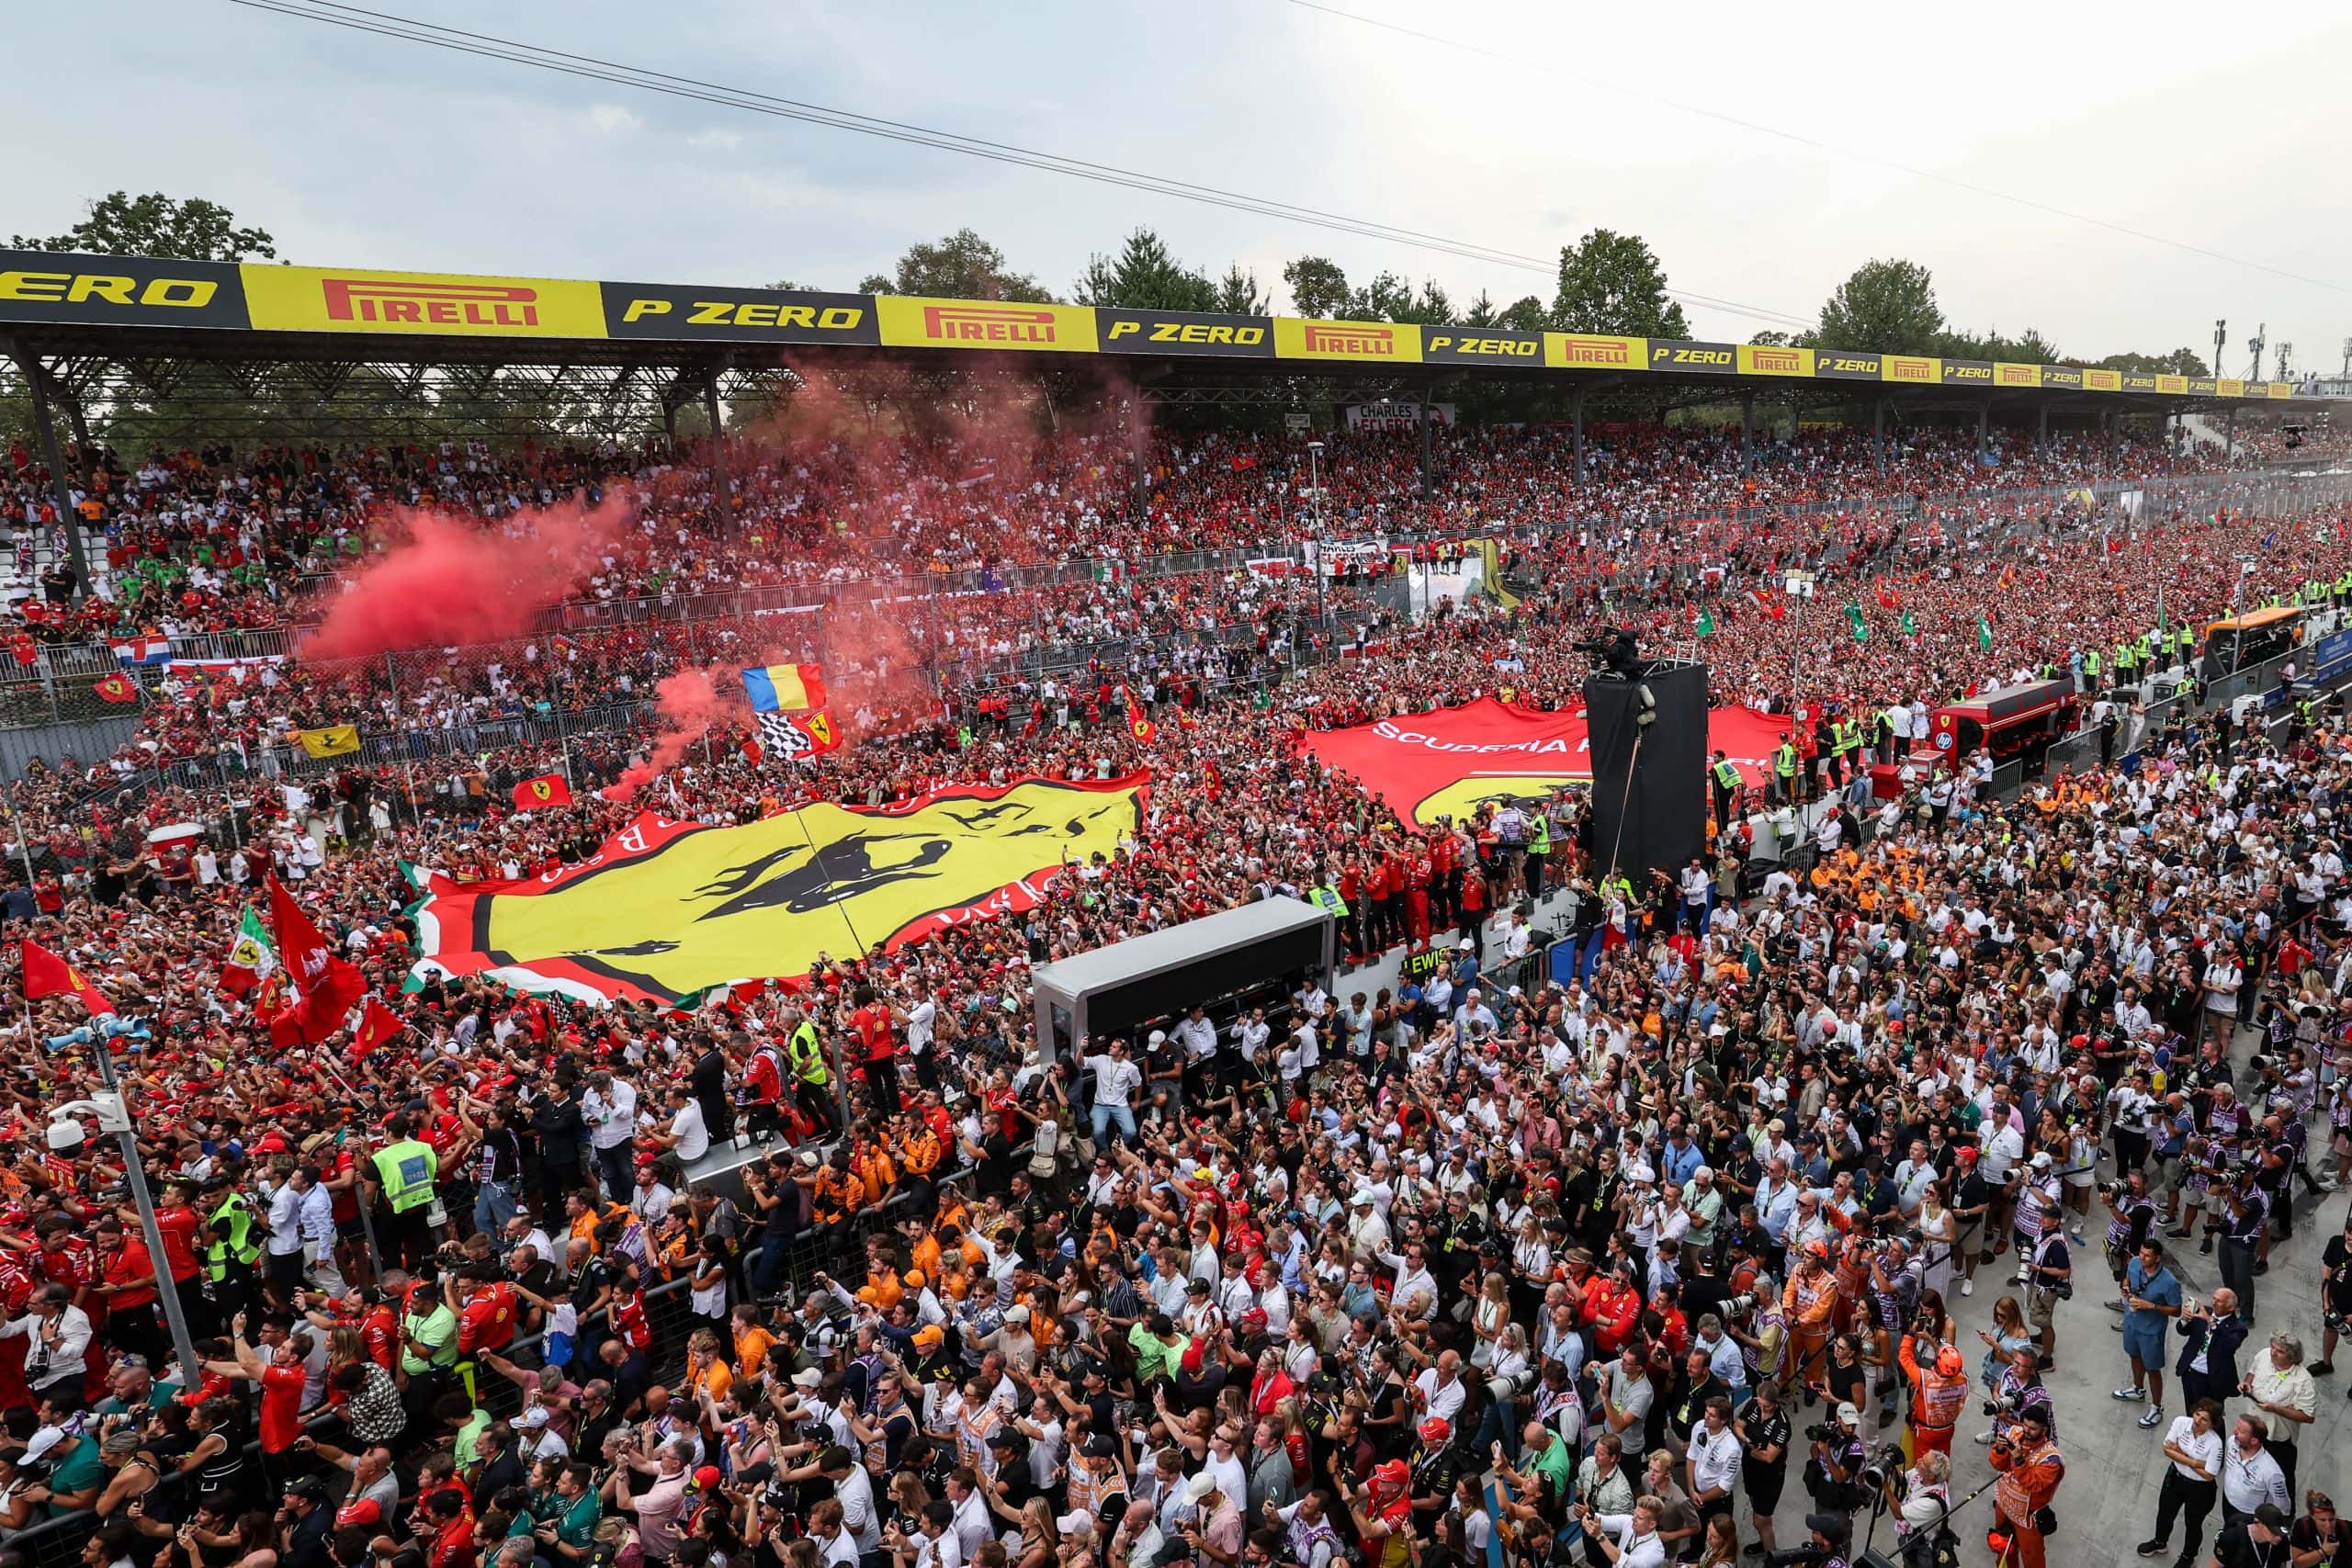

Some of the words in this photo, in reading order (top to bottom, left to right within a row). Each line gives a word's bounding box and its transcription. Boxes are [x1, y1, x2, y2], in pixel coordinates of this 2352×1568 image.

[322, 278, 538, 326] PIRELLI
[622, 299, 673, 322] P
[686, 301, 863, 330] ZERO
[923, 306, 1057, 343] PIRELLI
[1107, 321, 1140, 341] P
[1148, 323, 1264, 345] ZERO
[1305, 325, 1394, 355] PIRELLI
[1429, 336, 1452, 352] P
[1456, 338, 1537, 356] ZERO
[1565, 339, 1628, 364] PIRELLI
[1653, 348, 1668, 362] P
[1672, 349, 1732, 365] ZERO
[1753, 350, 1800, 372] PIRELLI
[1818, 357, 1832, 369] P
[1834, 359, 1878, 373] ZERO
[1894, 360, 1930, 378] PIRELLI
[1944, 367, 1954, 377] P
[1956, 367, 1992, 378] ZERO
[2003, 367, 2032, 383] PIRELLI
[2042, 372, 2052, 381] P
[2052, 372, 2081, 384] ZERO
[2131, 378, 2154, 388] ZERO
[1360, 404, 1412, 418] CHARLES
[127, 638, 148, 662] 1
[1937, 733, 1951, 749] hp
